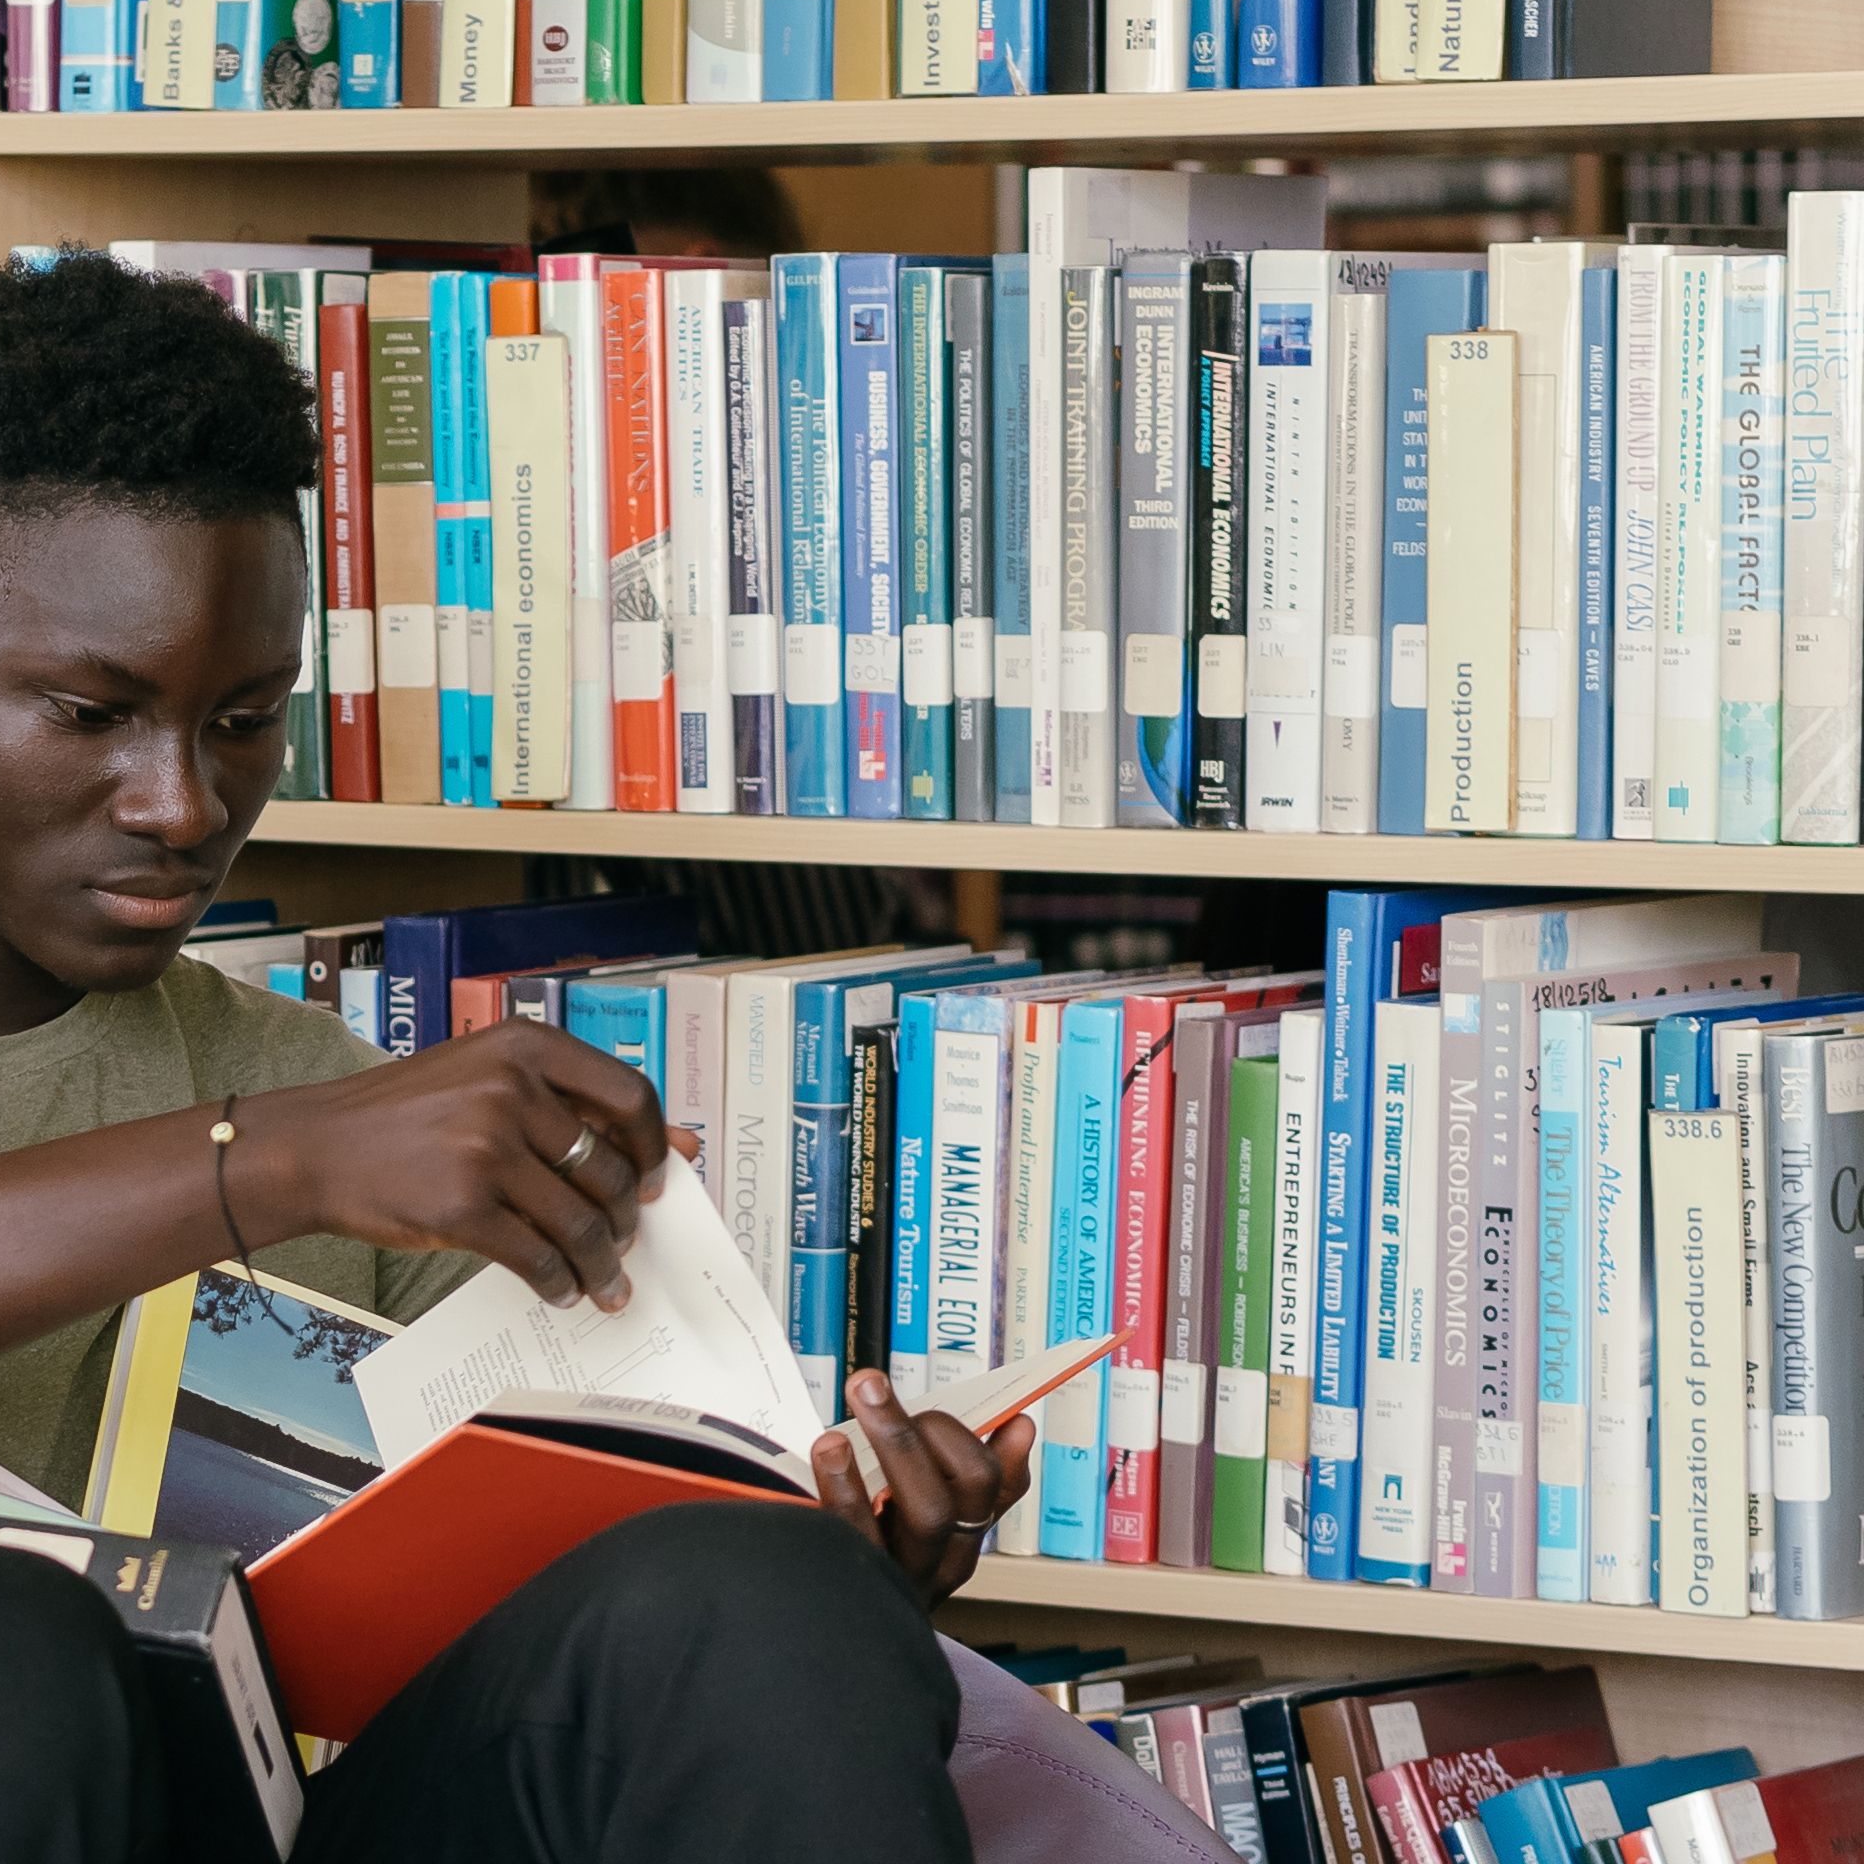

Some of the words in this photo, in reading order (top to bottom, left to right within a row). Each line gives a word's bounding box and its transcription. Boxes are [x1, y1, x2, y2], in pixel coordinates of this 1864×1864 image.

[162, 18, 182, 100] Banks
[460, 12, 483, 104] Money
[1128, 286, 1183, 300] INGRAM
[1135, 305, 1174, 318] DUNN
[505, 343, 540, 362] 337
[1135, 325, 1151, 454] ECONOMICS
[1450, 340, 1488, 361] 338
[1157, 325, 1174, 492] INTERNATIONAL
[512, 463, 533, 613] economics
[1128, 515, 1179, 529] EDITION
[1134, 499, 1173, 513] THIRD
[512, 624, 535, 795] International
[1450, 660, 1475, 822] Production
[1664, 1117, 1723, 1140] 338.6
[899, 1136, 920, 1220] Nature
[938, 1142, 981, 1284] MANAGERIAL
[1444, 1076, 1478, 1369] MICROECONOMICS
[895, 1223, 917, 1326] Tourism
[1683, 1206, 1711, 1368] production
[937, 1297, 979, 1354] ECON
[1686, 1378, 1707, 1413] of
[1686, 1418, 1711, 1607] Organization
